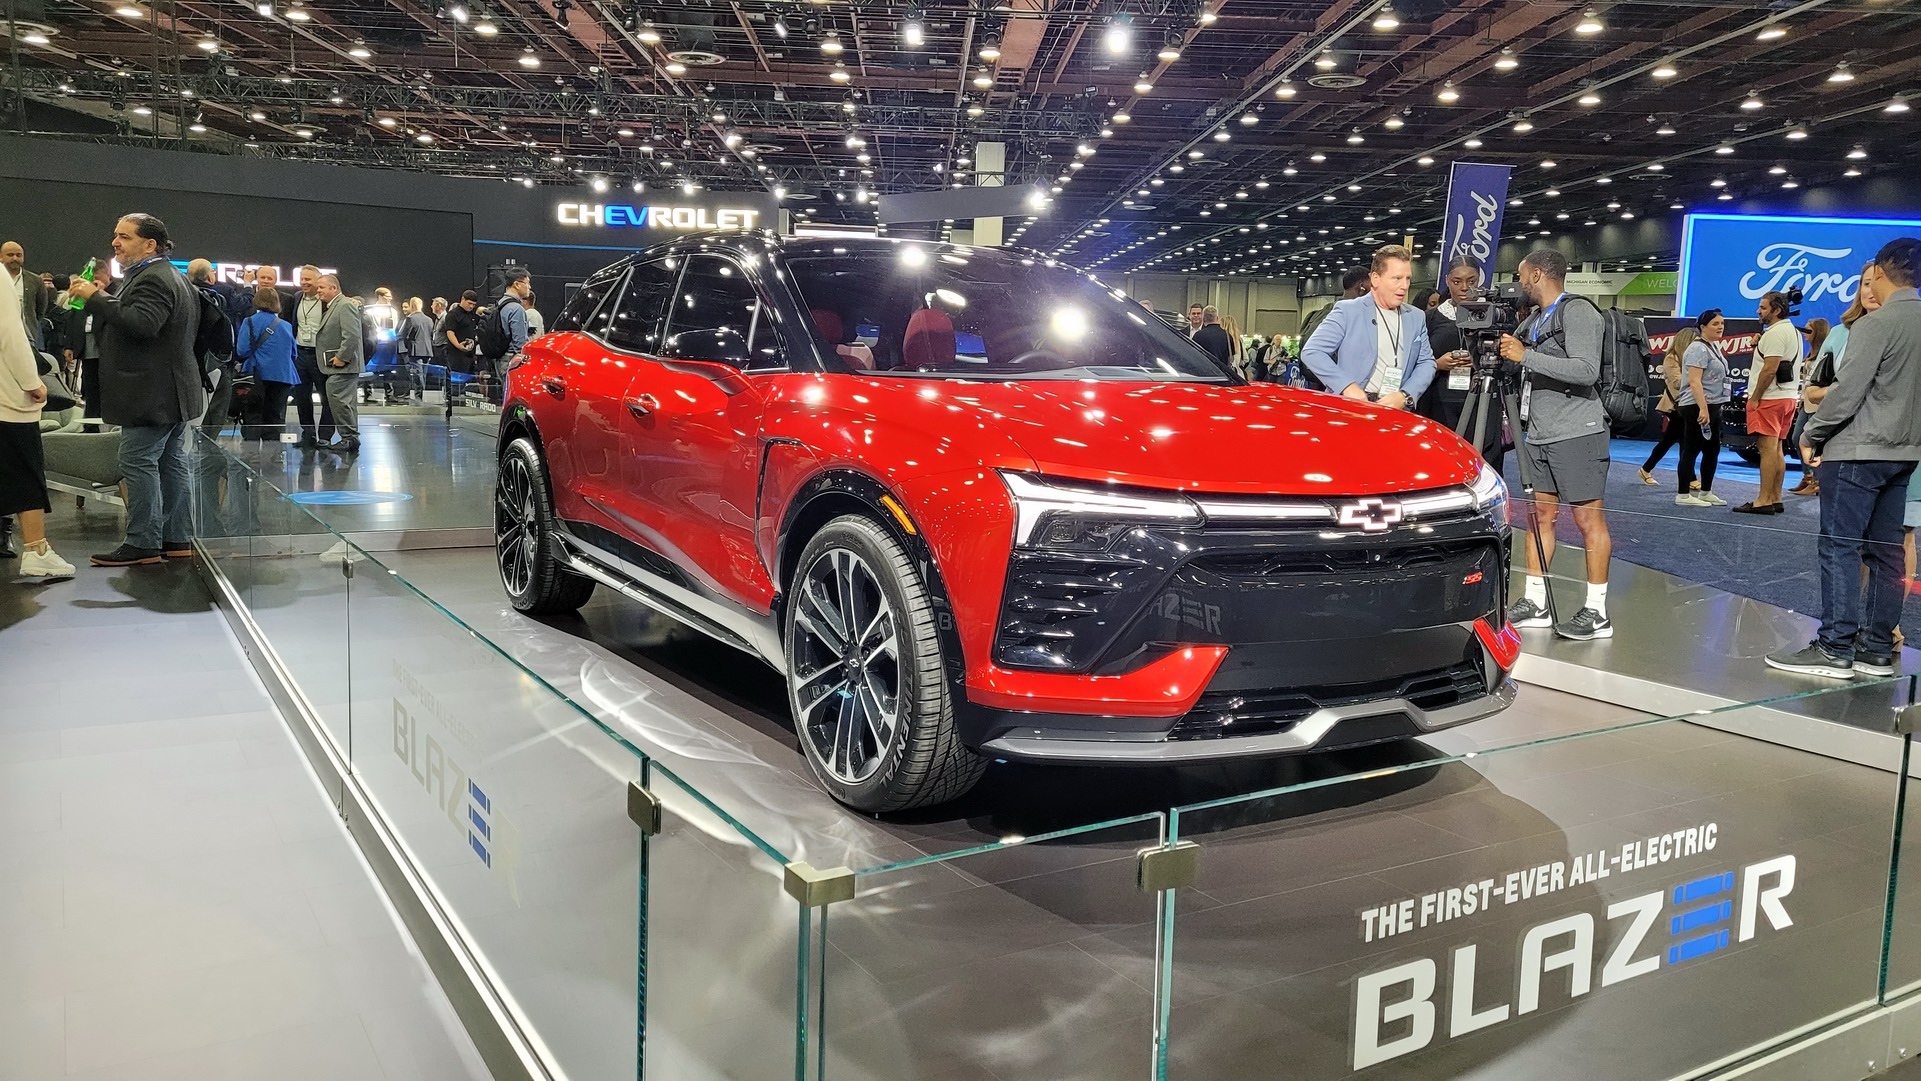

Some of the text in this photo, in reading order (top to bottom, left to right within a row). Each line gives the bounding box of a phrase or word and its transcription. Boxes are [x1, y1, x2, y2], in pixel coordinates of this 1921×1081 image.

[557, 203, 759, 229] CHEVROLET
[1646, 278, 1677, 288] WELC
[1648, 336, 1676, 352] WJ
[1715, 335, 1752, 354] WJR
[1361, 822, 1719, 943] THE FIRST-EVER ALL-ELECTRIC
[1353, 854, 1797, 1072] BLAZER
